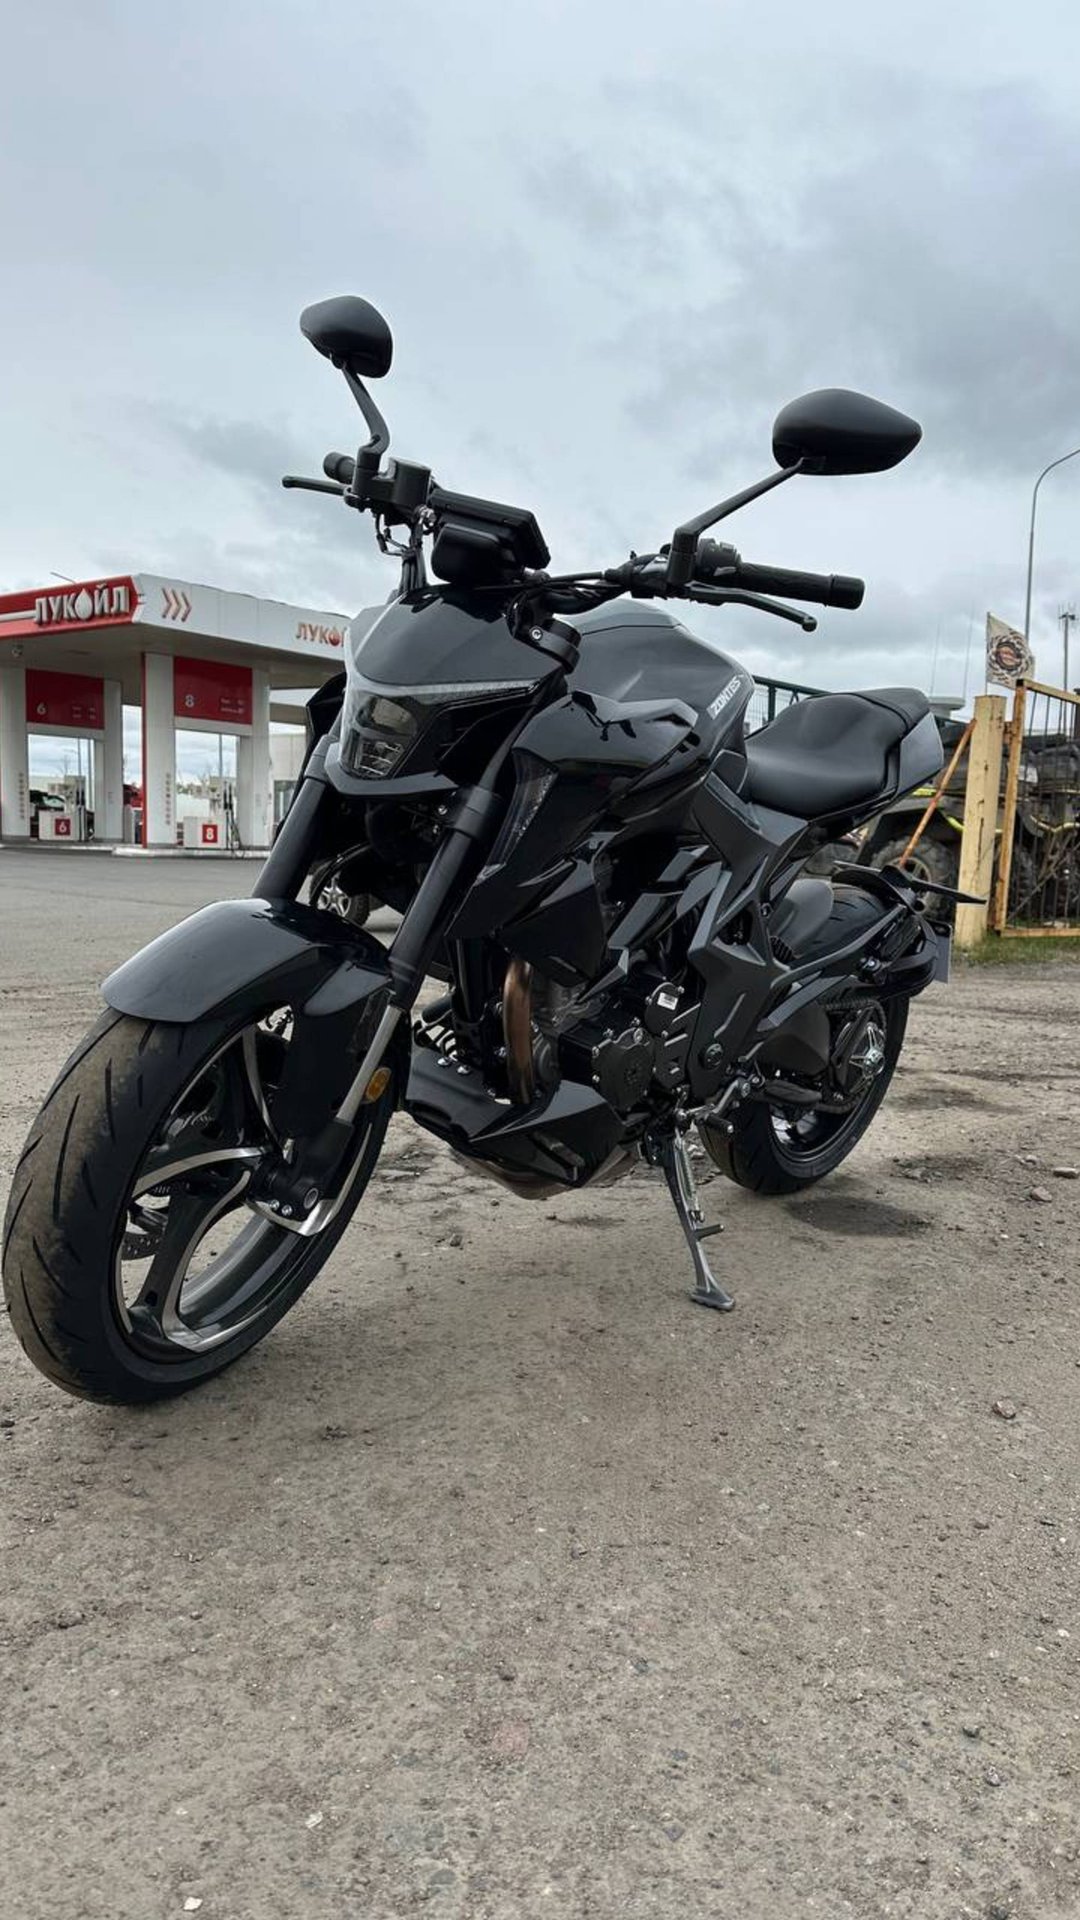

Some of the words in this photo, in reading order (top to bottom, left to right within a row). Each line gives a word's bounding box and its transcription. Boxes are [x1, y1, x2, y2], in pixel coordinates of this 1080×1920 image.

[34, 583, 130, 625] ЛУКОЙЛ
[185, 694, 195, 708] 8
[709, 676, 741, 716] ZONTES
[37, 702, 47, 715] 6
[59, 821, 68, 834] 6
[205, 827, 215, 841] 8
